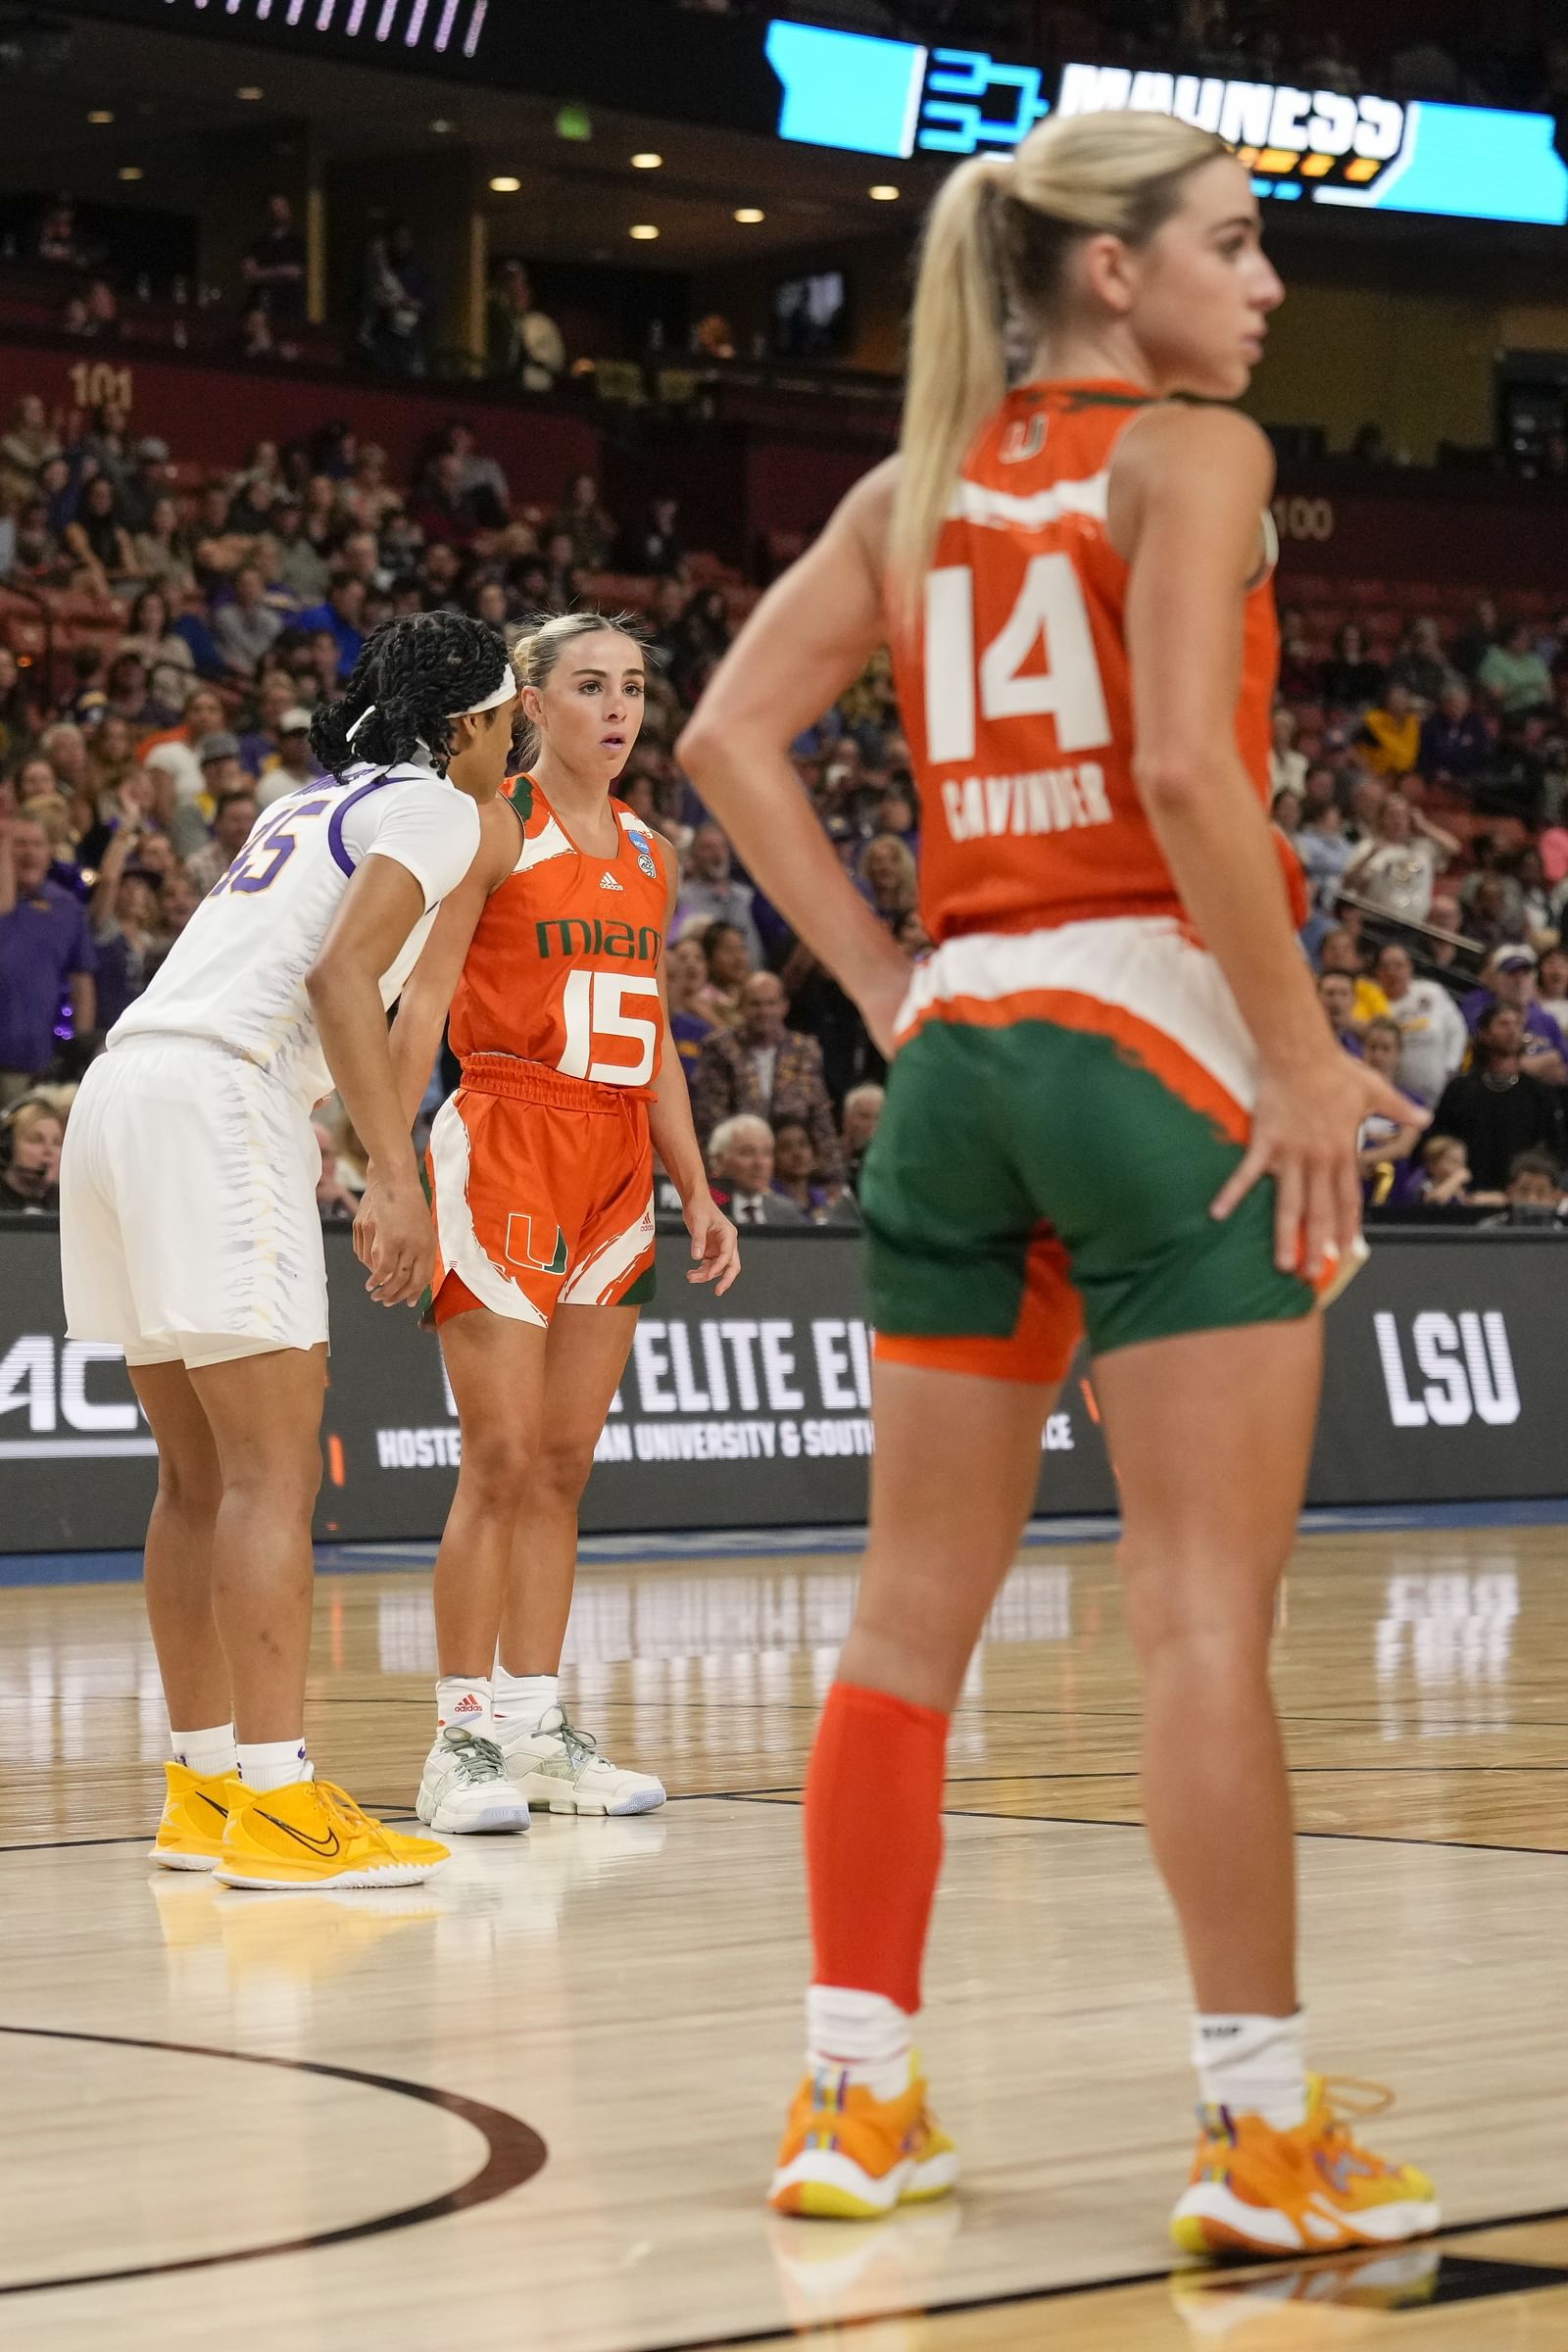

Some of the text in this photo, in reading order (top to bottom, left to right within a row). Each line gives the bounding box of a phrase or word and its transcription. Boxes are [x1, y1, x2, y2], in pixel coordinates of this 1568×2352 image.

[69, 363, 132, 410] 101
[924, 551, 1113, 766] 14
[942, 761, 1113, 843] CAVINDER
[556, 969, 660, 1087] 15
[0, 1335, 149, 1432] AC
[634, 1318, 805, 1412] ELITE
[1373, 1311, 1521, 1427] LSU
[376, 1427, 463, 1469] HOSTE
[633, 1421, 776, 1462] UNIVERSITY
[780, 1419, 801, 1458] &
